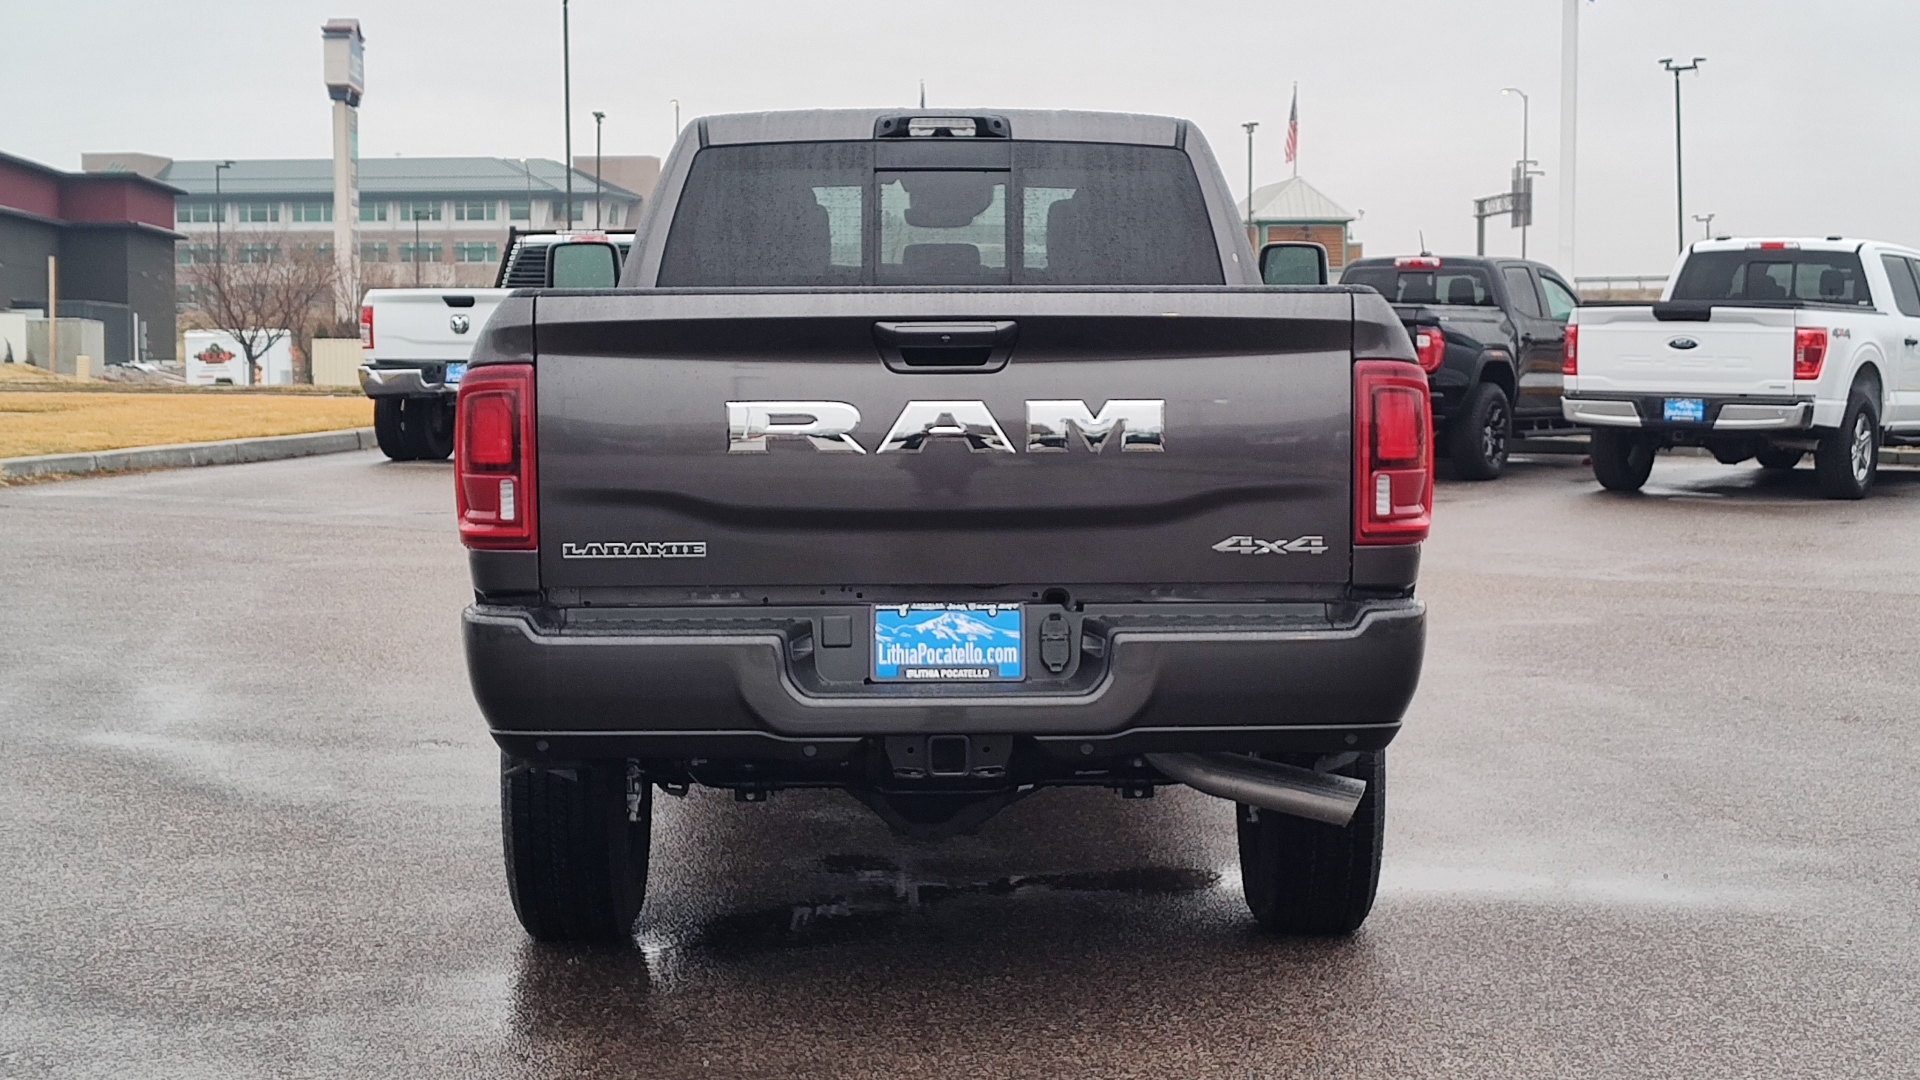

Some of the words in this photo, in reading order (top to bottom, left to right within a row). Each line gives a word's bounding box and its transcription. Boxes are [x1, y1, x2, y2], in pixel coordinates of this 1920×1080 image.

[725, 399, 1166, 454] RAM
[562, 542, 707, 558] LARAMIE
[1212, 536, 1328, 554] 4x4
[878, 642, 1017, 664] LithiaPocatello.com
[941, 669, 990, 678] POCATELLO
